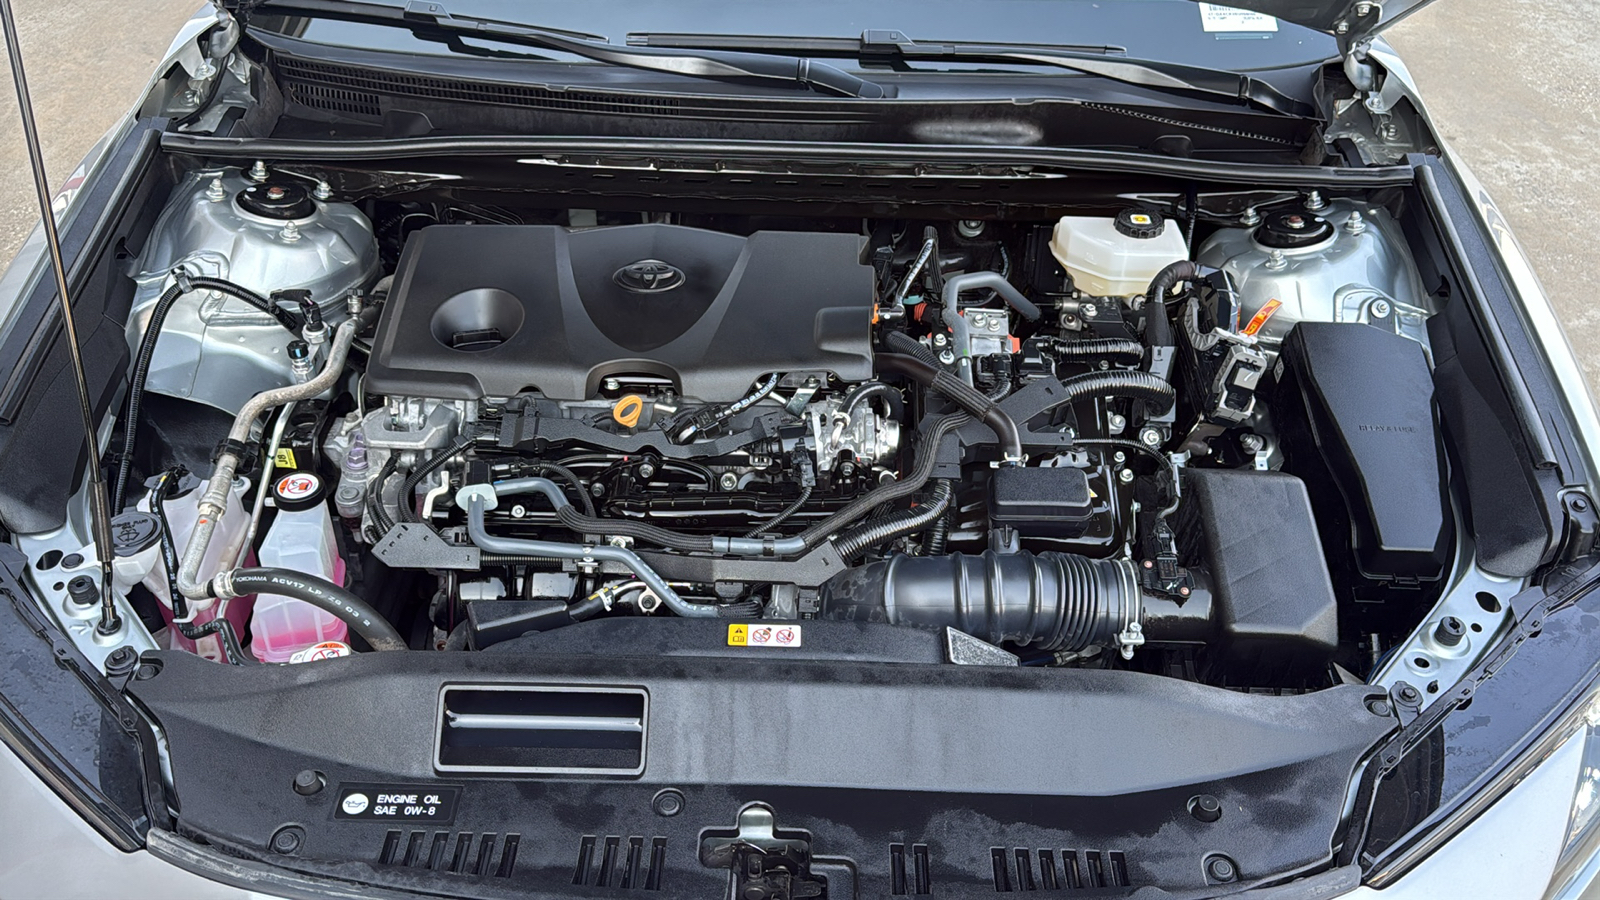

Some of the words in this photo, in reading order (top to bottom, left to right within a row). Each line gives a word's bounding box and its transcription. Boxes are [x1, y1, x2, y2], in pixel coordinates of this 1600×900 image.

[271, 577, 305, 588] ACV17
[308, 587, 323, 595] LP
[376, 794, 418, 804] ENGINE
[423, 795, 442, 804] OIL
[373, 806, 398, 815] SAE
[404, 807, 436, 816] 0W-8
